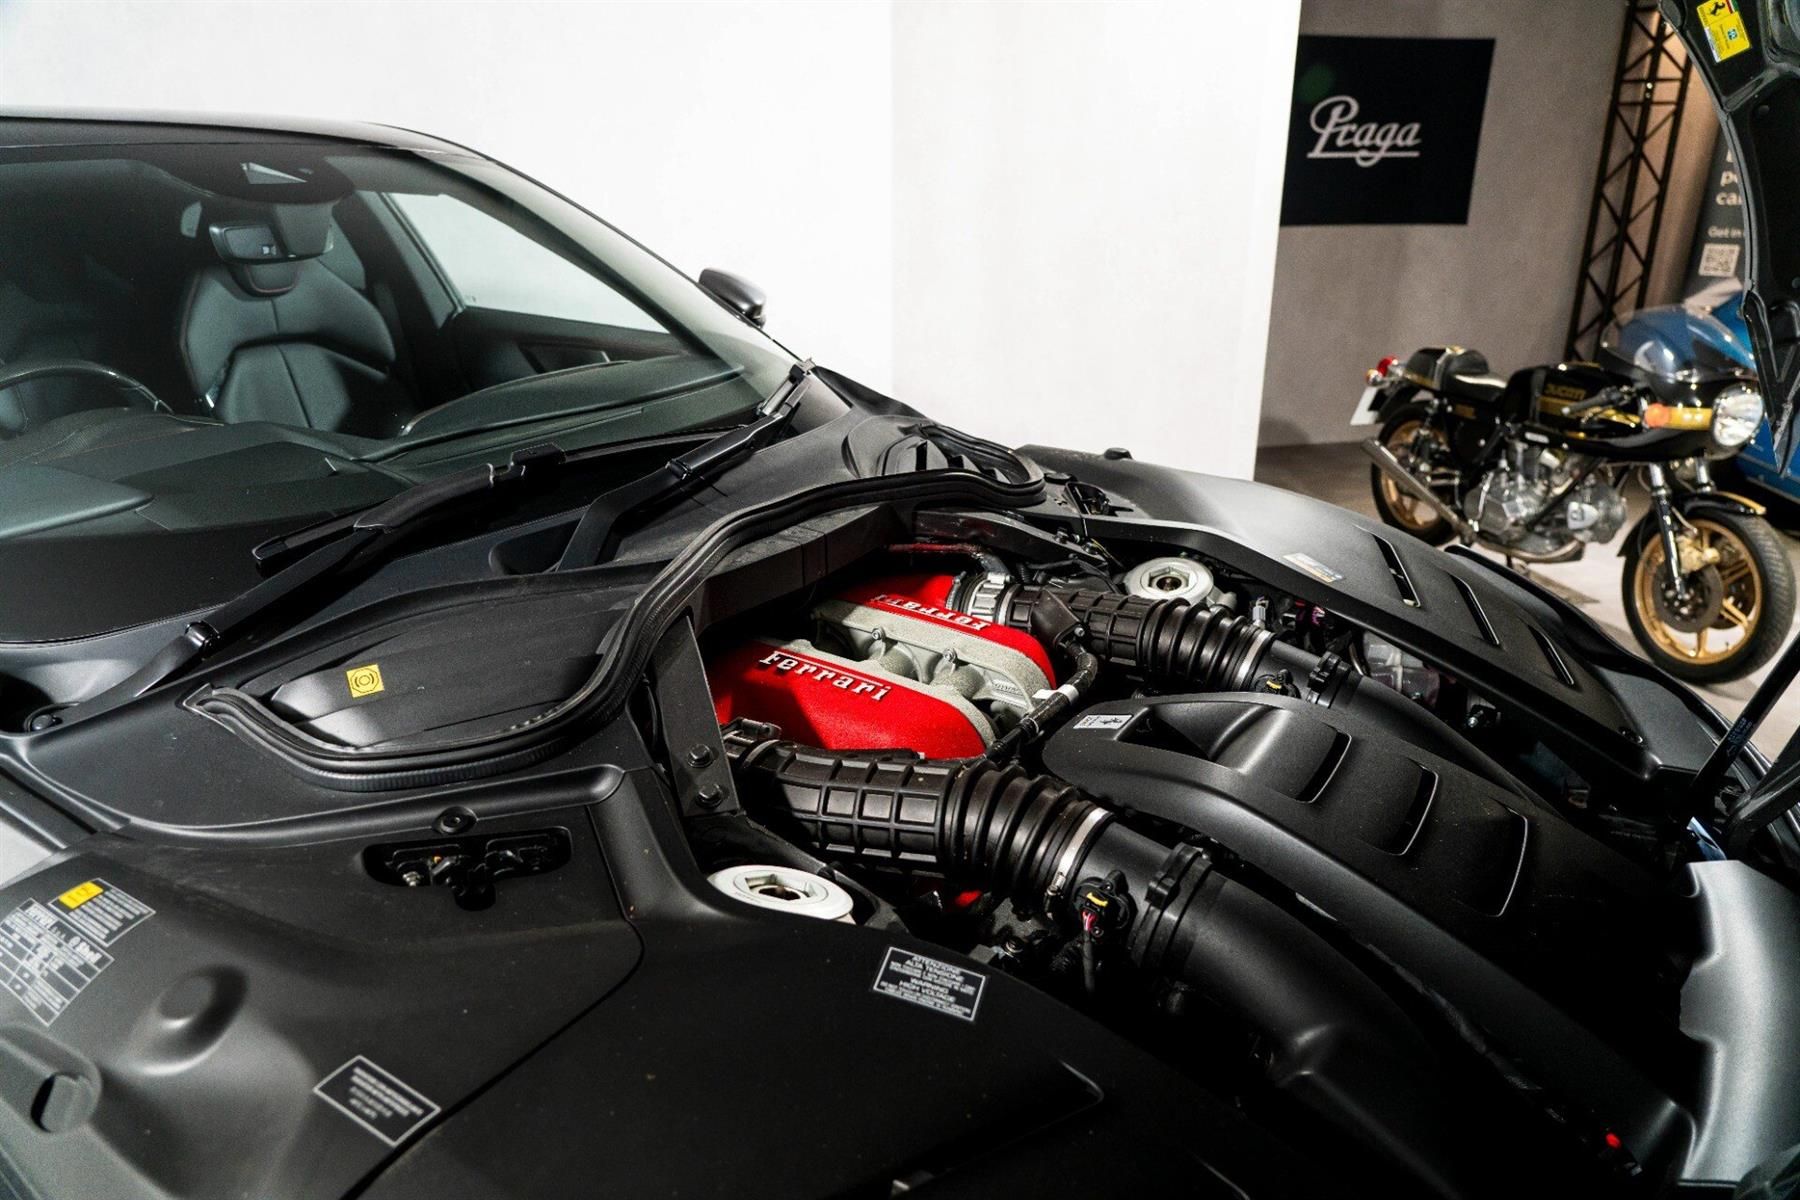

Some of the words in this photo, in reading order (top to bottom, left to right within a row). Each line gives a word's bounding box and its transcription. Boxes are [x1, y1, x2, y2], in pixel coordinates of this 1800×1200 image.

[1307, 95, 1422, 168] Praga
[760, 650, 892, 701] Ferrari
[910, 978, 949, 994] WARNING
